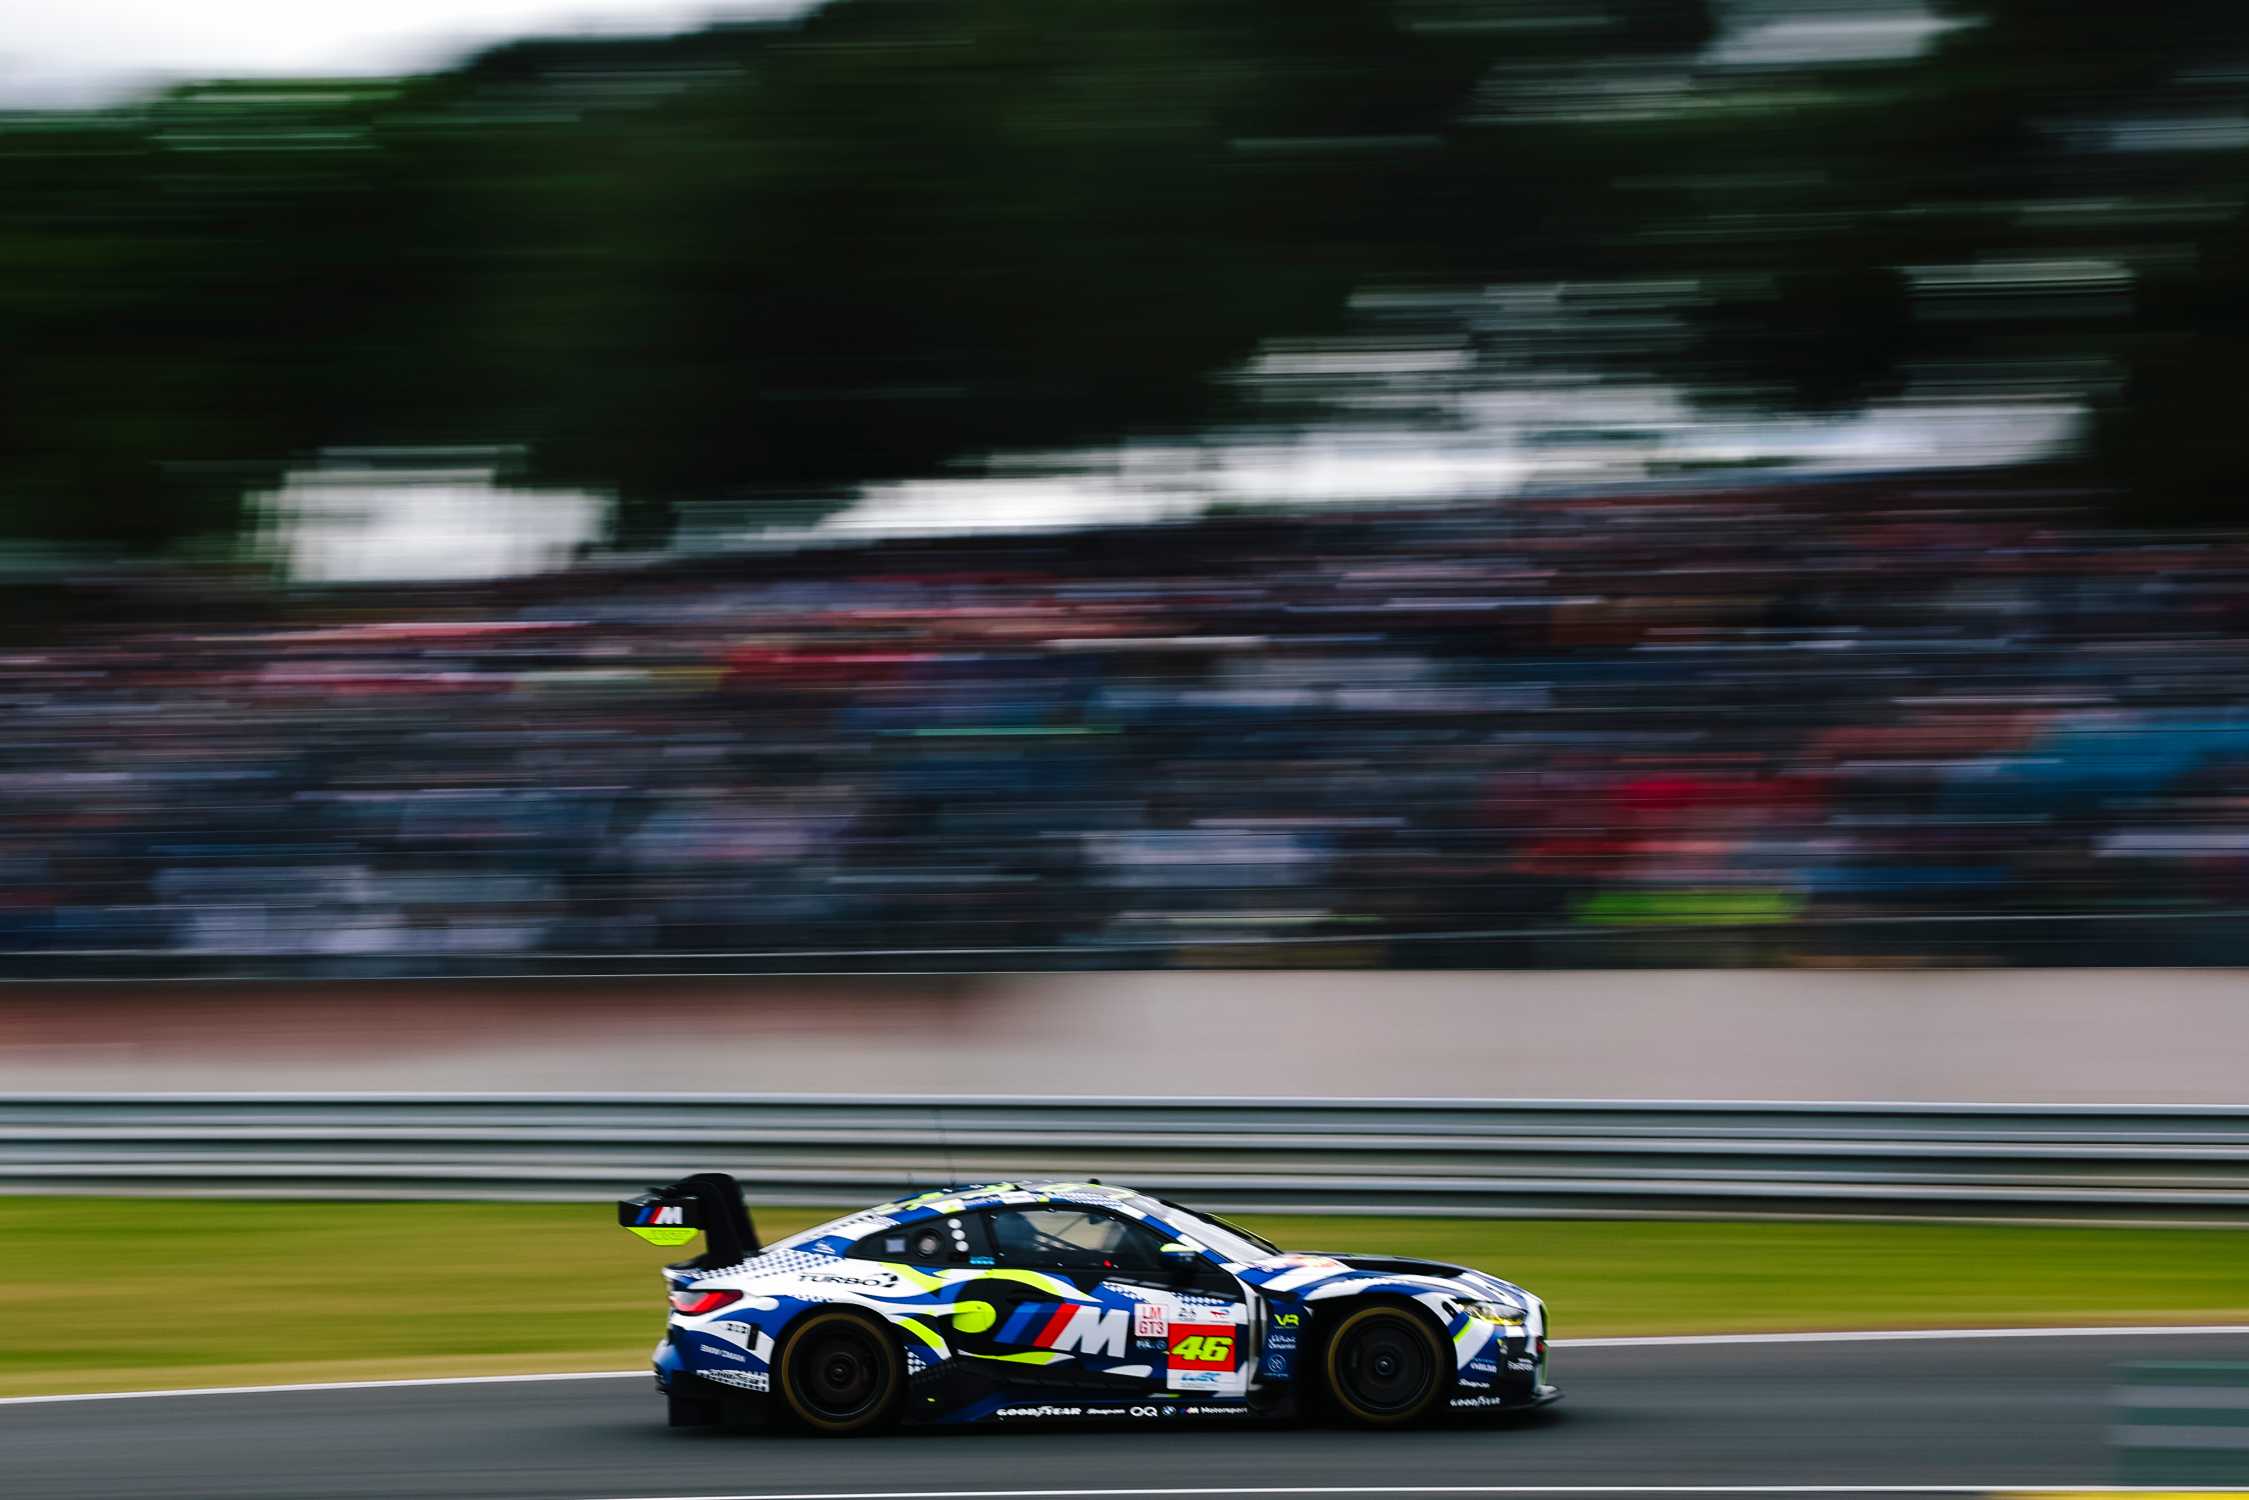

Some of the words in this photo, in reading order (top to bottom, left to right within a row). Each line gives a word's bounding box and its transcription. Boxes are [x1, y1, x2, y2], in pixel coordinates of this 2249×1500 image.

[654, 1206, 683, 1225] M
[800, 1274, 880, 1286] TURBO
[1142, 1306, 1161, 1319] LM
[1049, 1304, 1131, 1359] M
[1139, 1320, 1165, 1335] GT3
[1170, 1335, 1234, 1362] 46
[1129, 1406, 1158, 1417] OQ
